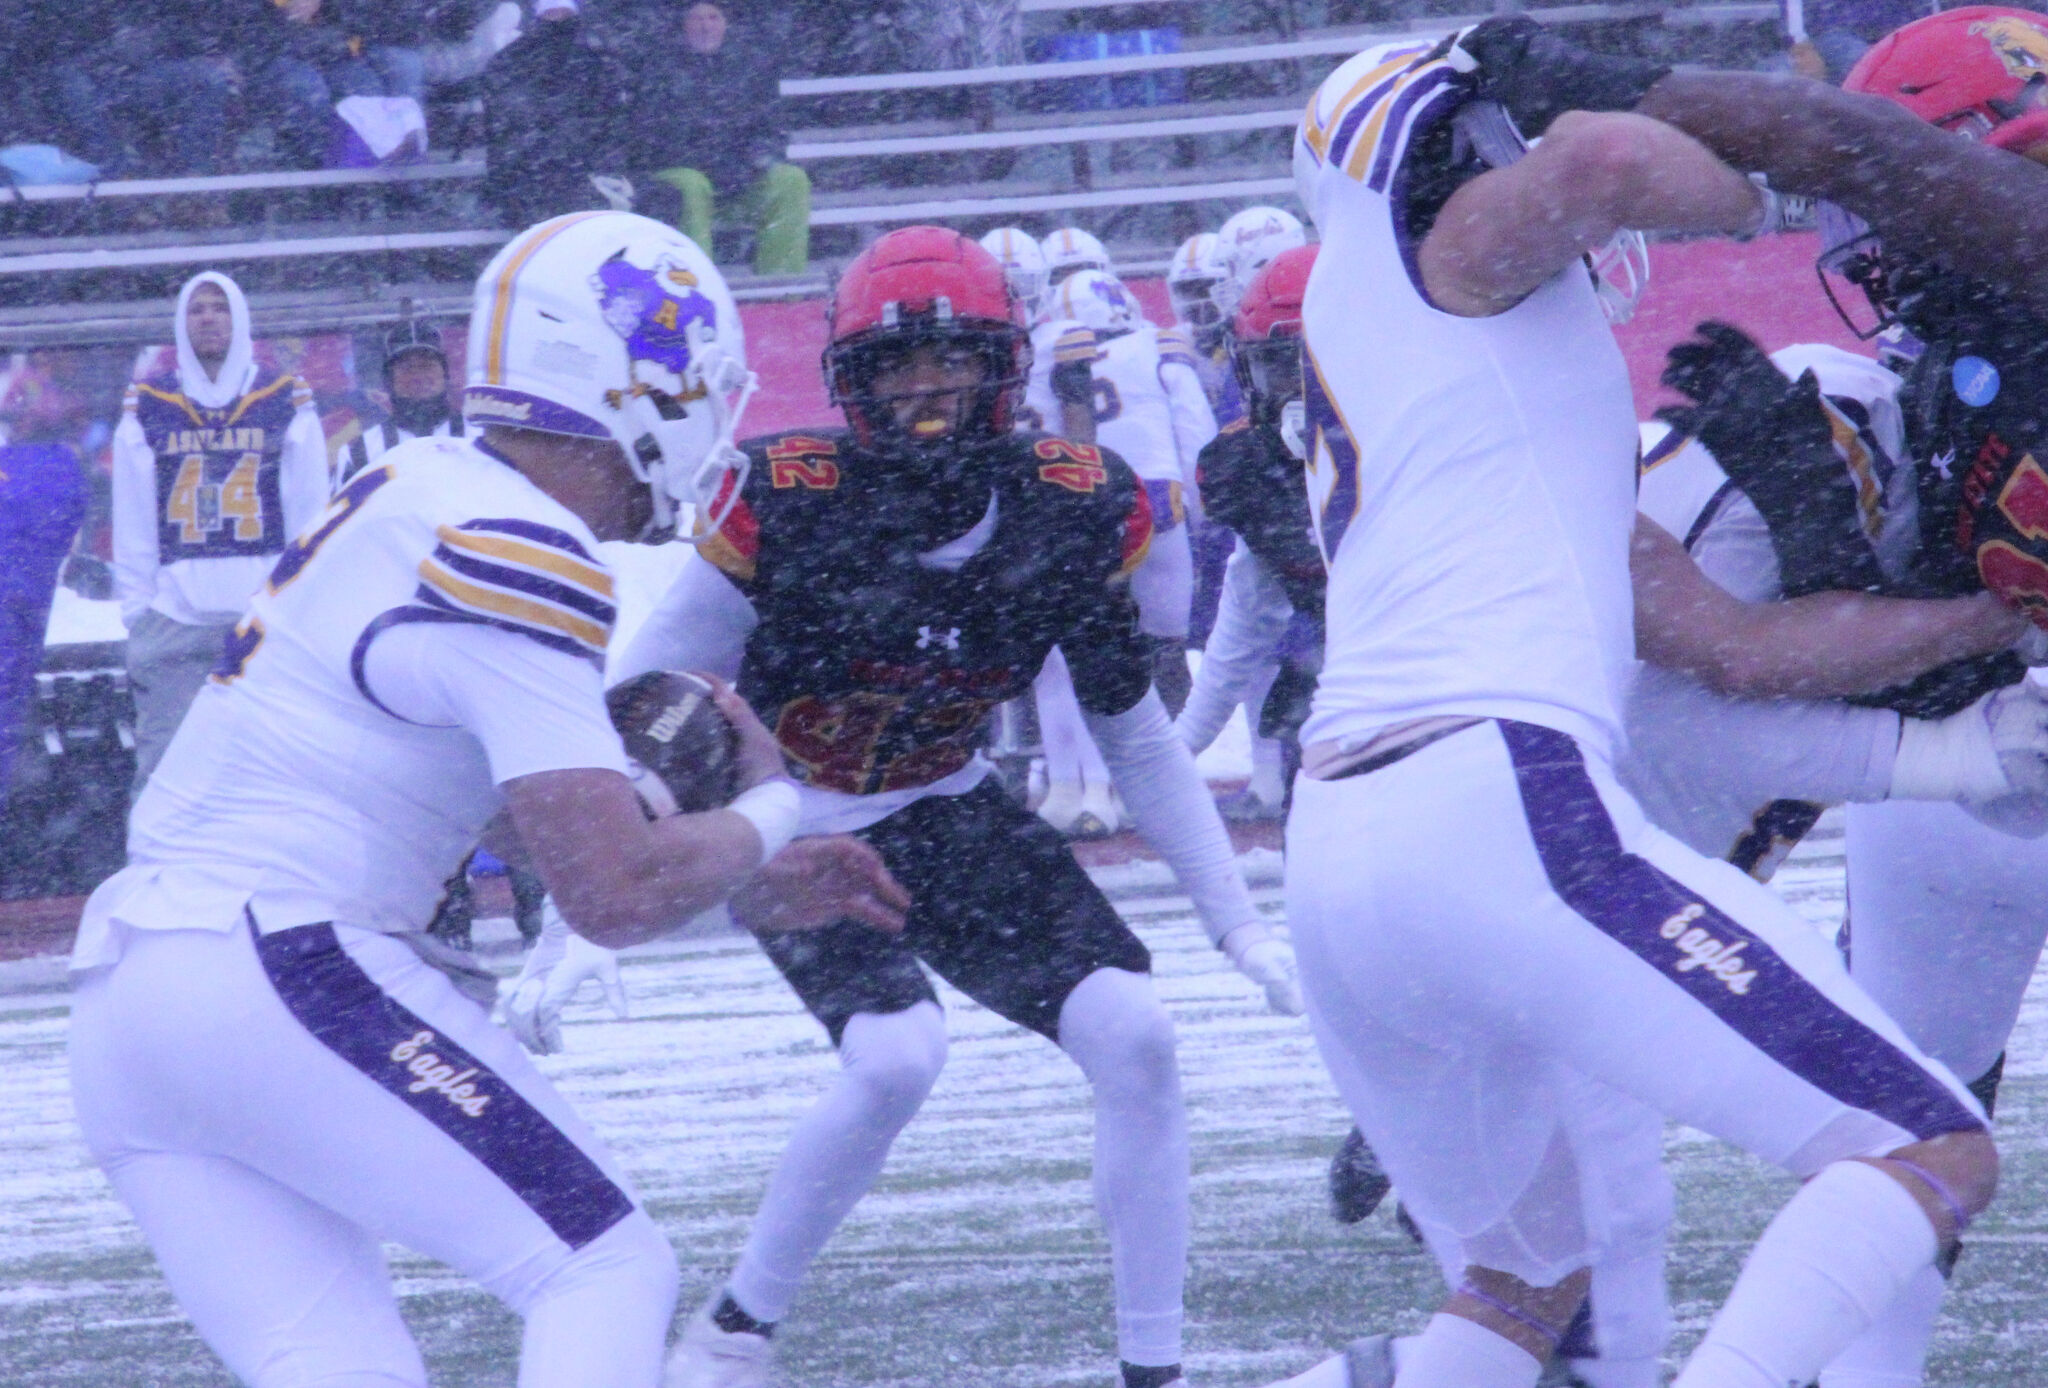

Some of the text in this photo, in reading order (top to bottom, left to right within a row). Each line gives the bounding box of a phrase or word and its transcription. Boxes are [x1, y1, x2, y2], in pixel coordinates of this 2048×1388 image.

[653, 299, 679, 330] A
[167, 452, 264, 543] 44
[766, 436, 840, 489] 42
[1034, 438, 1107, 493] 42
[1660, 903, 1757, 994] Eagles
[390, 1031, 490, 1117] Eagles
